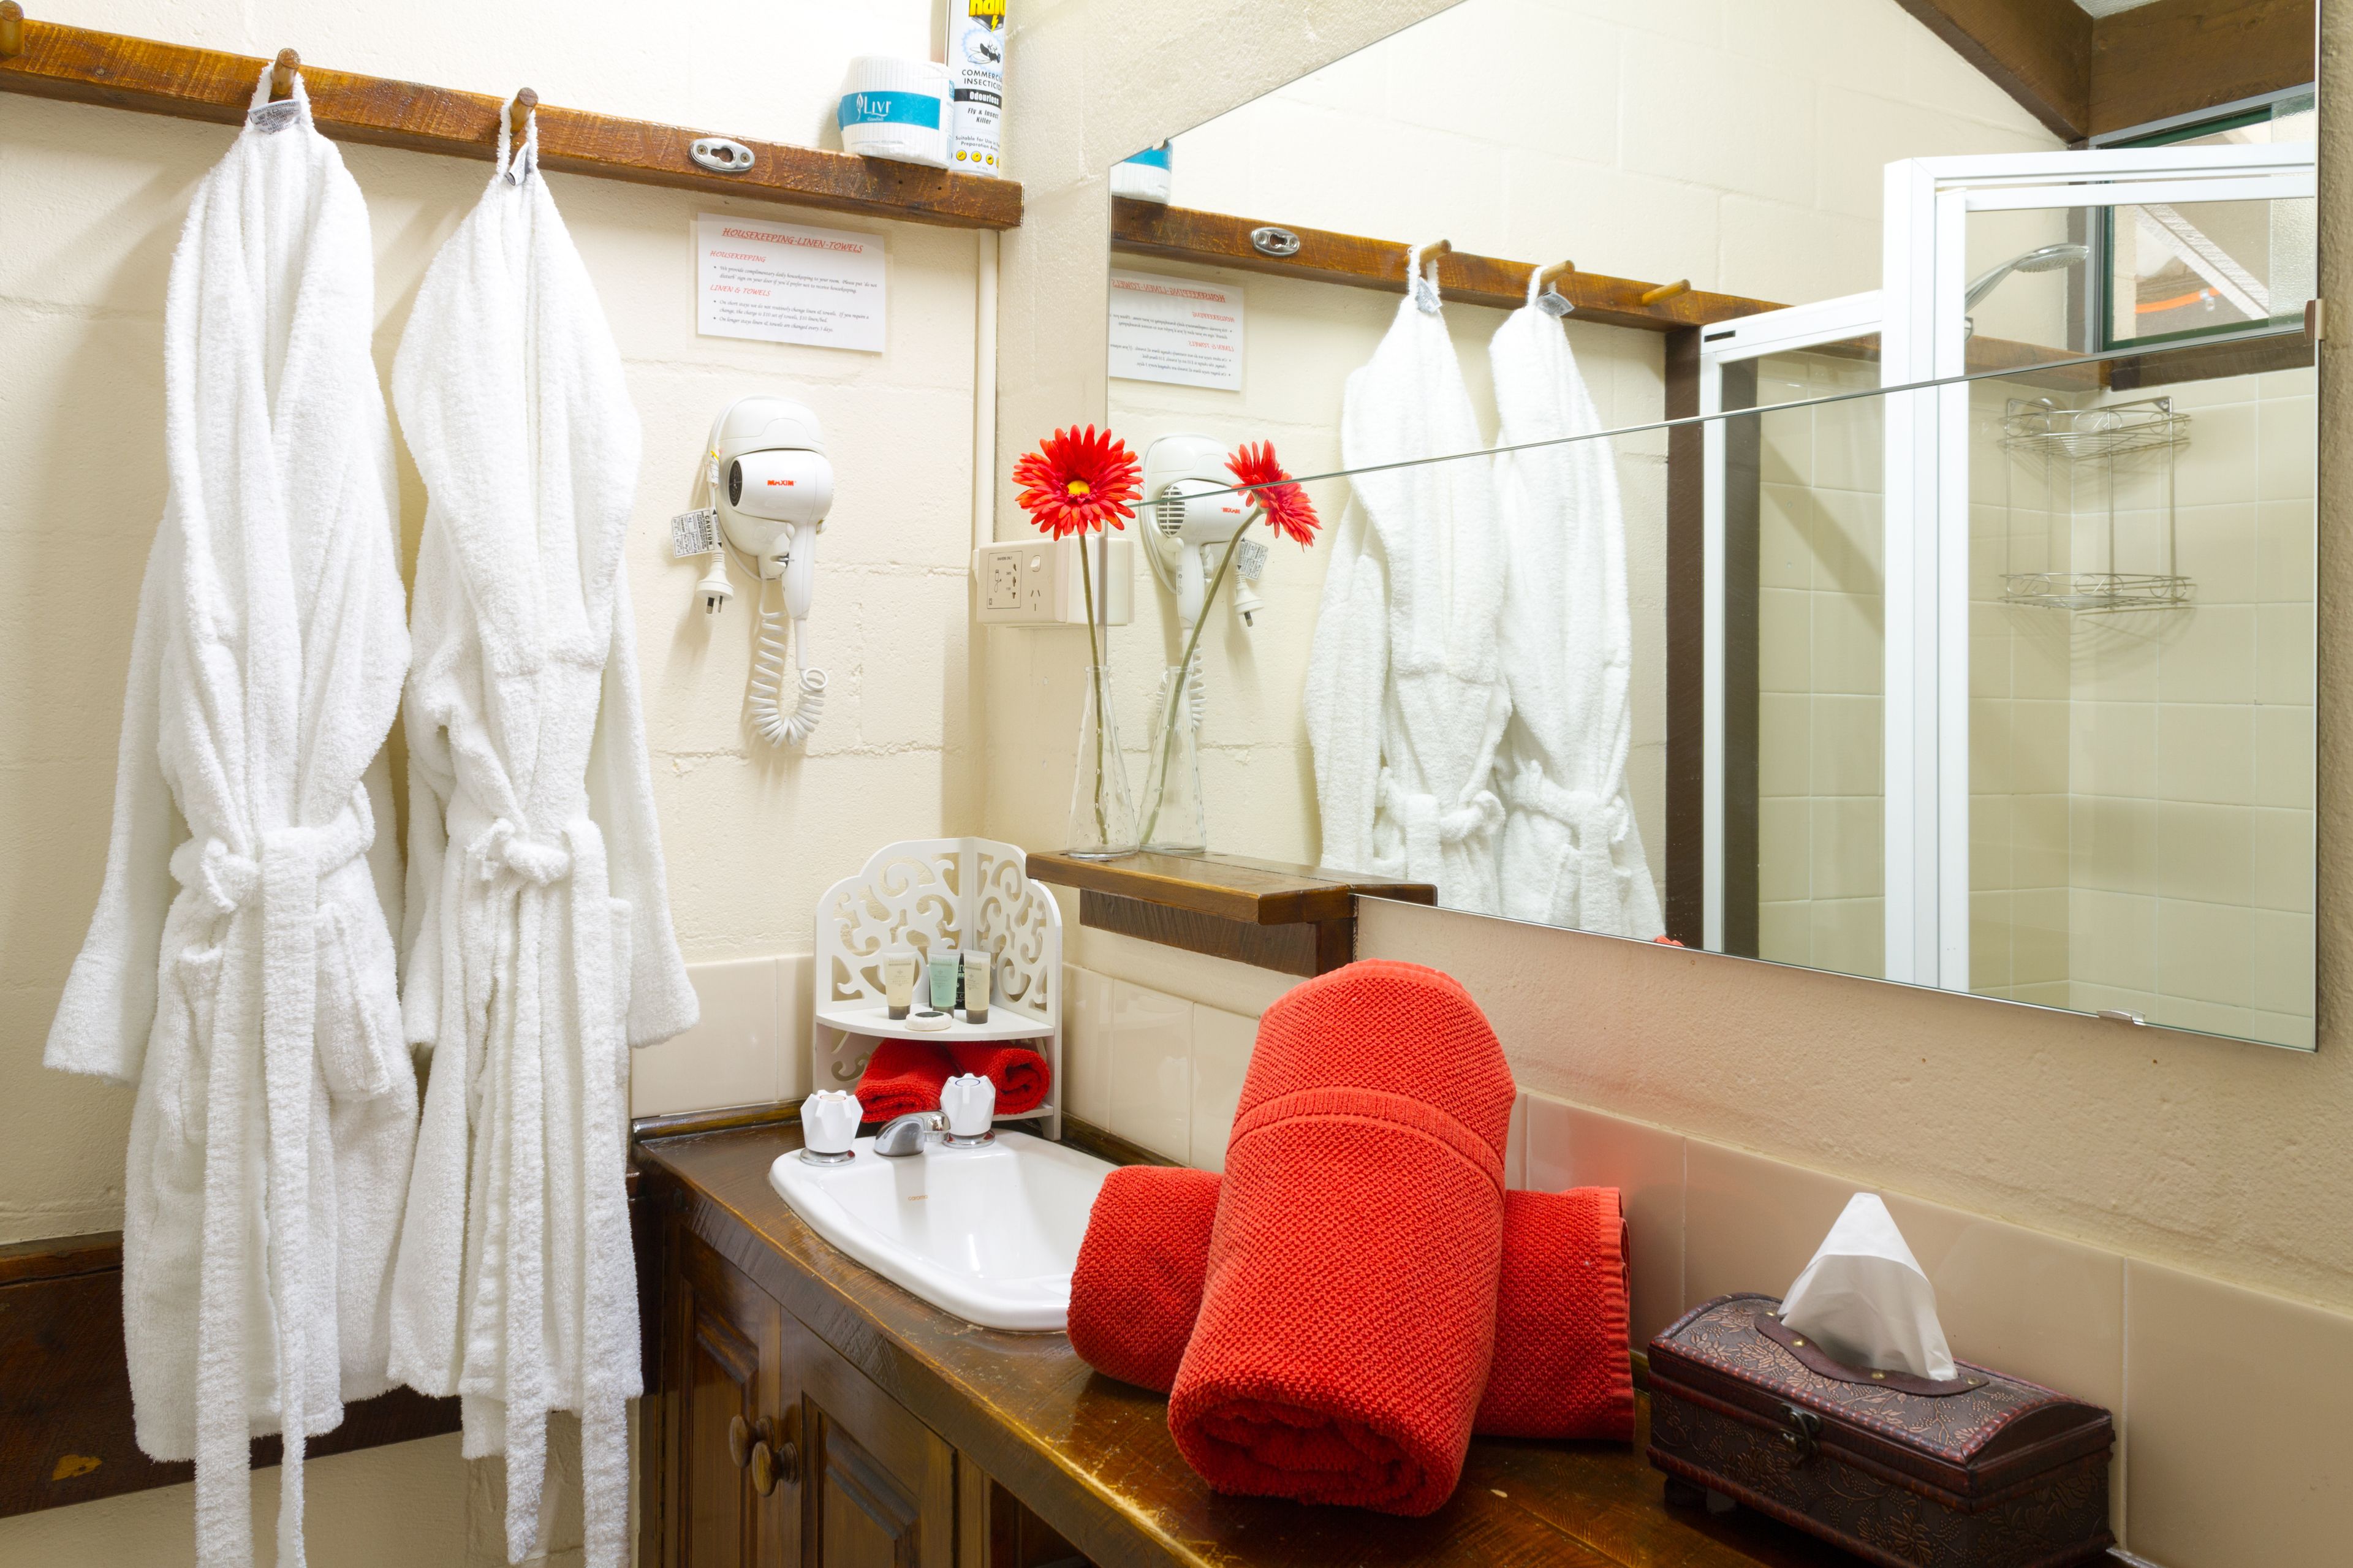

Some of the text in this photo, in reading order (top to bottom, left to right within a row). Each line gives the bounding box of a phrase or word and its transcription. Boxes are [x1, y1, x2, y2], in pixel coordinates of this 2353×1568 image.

[961, 69, 1002, 83] COMMERCIA
[964, 78, 1002, 92] INSECTICID
[969, 91, 999, 105] Odourless
[984, 110, 999, 119] Insect
[710, 250, 765, 262] HOUSEKEEPING
[743, 288, 771, 297] TOWELS
